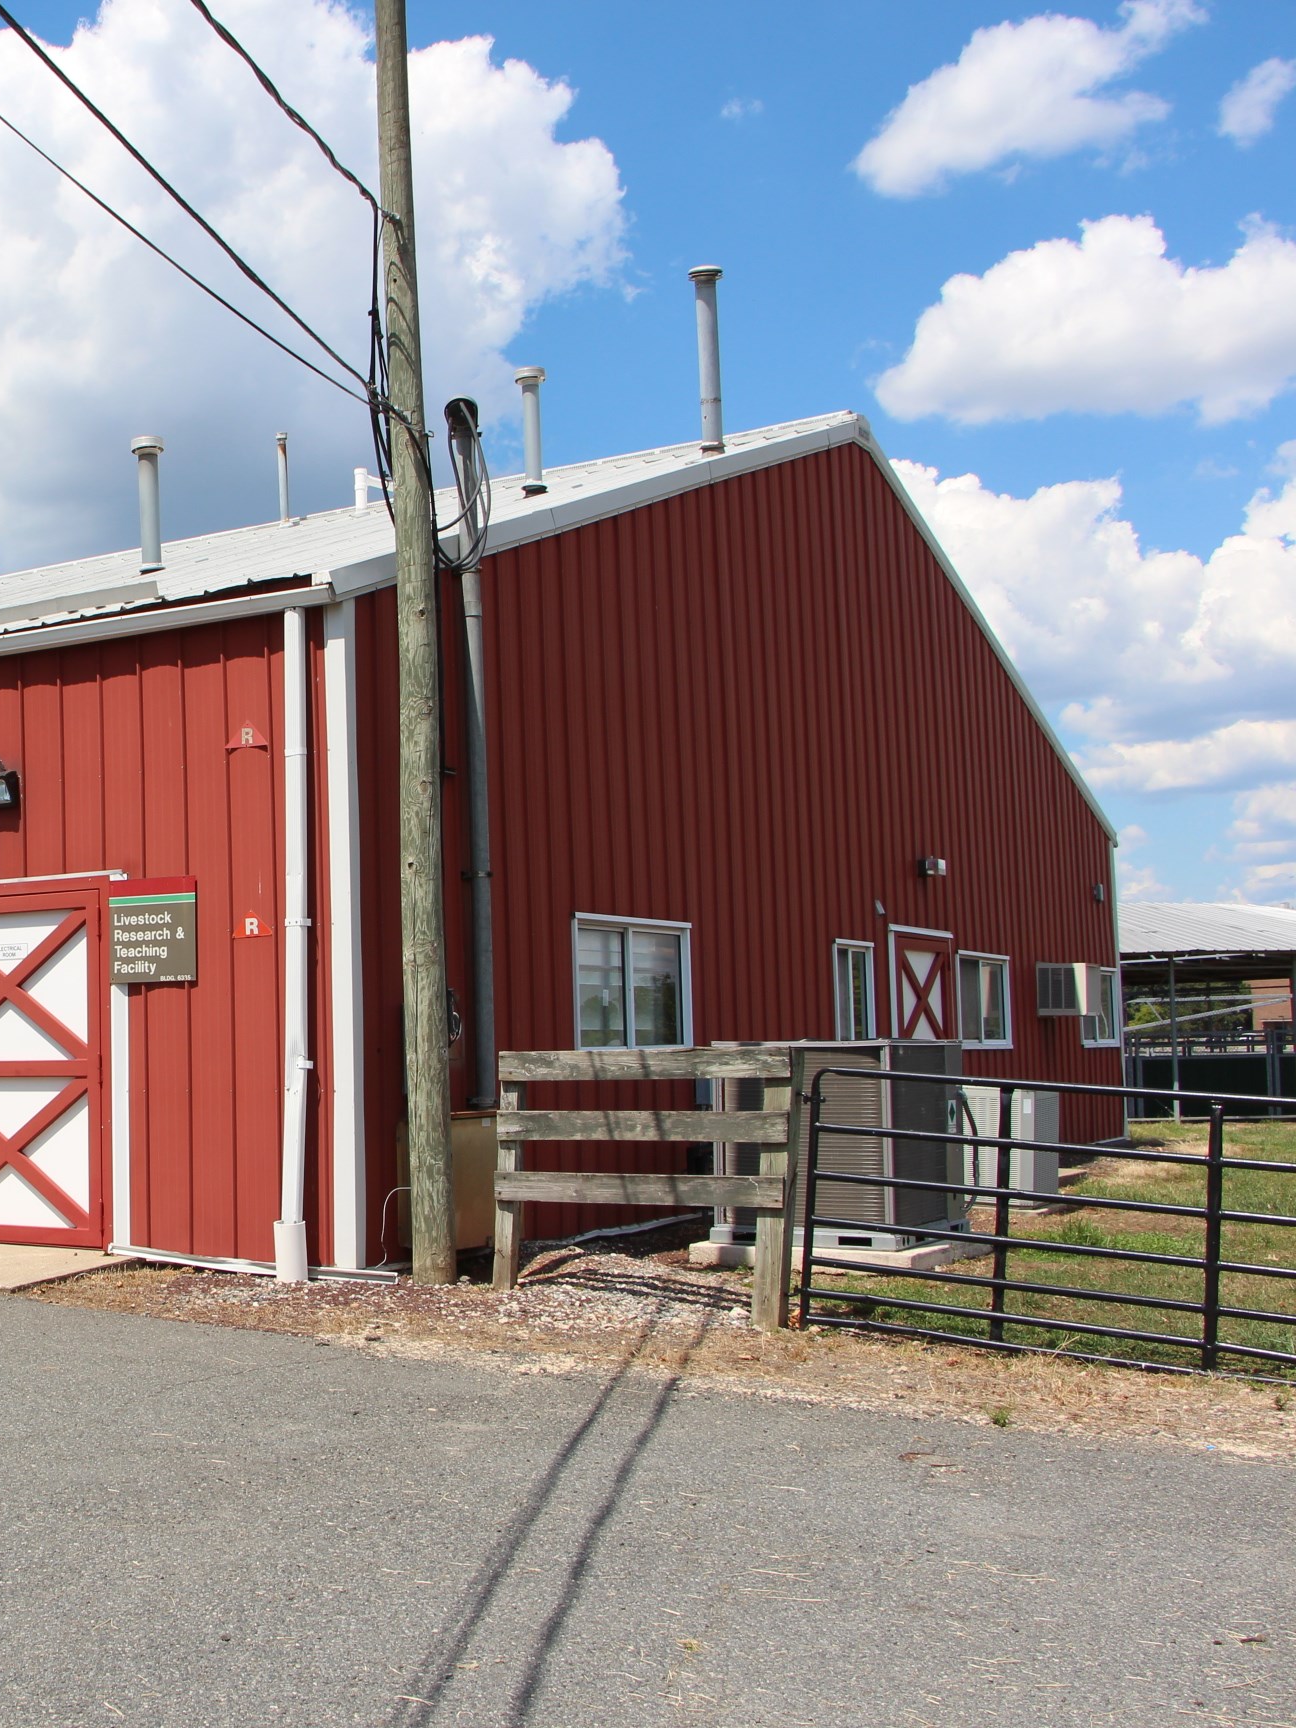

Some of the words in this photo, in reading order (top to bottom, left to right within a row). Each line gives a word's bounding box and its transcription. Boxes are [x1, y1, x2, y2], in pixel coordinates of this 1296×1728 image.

[242, 728, 253, 744] R
[114, 911, 172, 926] Livestock
[114, 928, 171, 942] Research
[175, 926, 185, 939] &
[245, 918, 259, 935] R
[114, 944, 168, 959] Teaching
[114, 961, 157, 975] Facility
